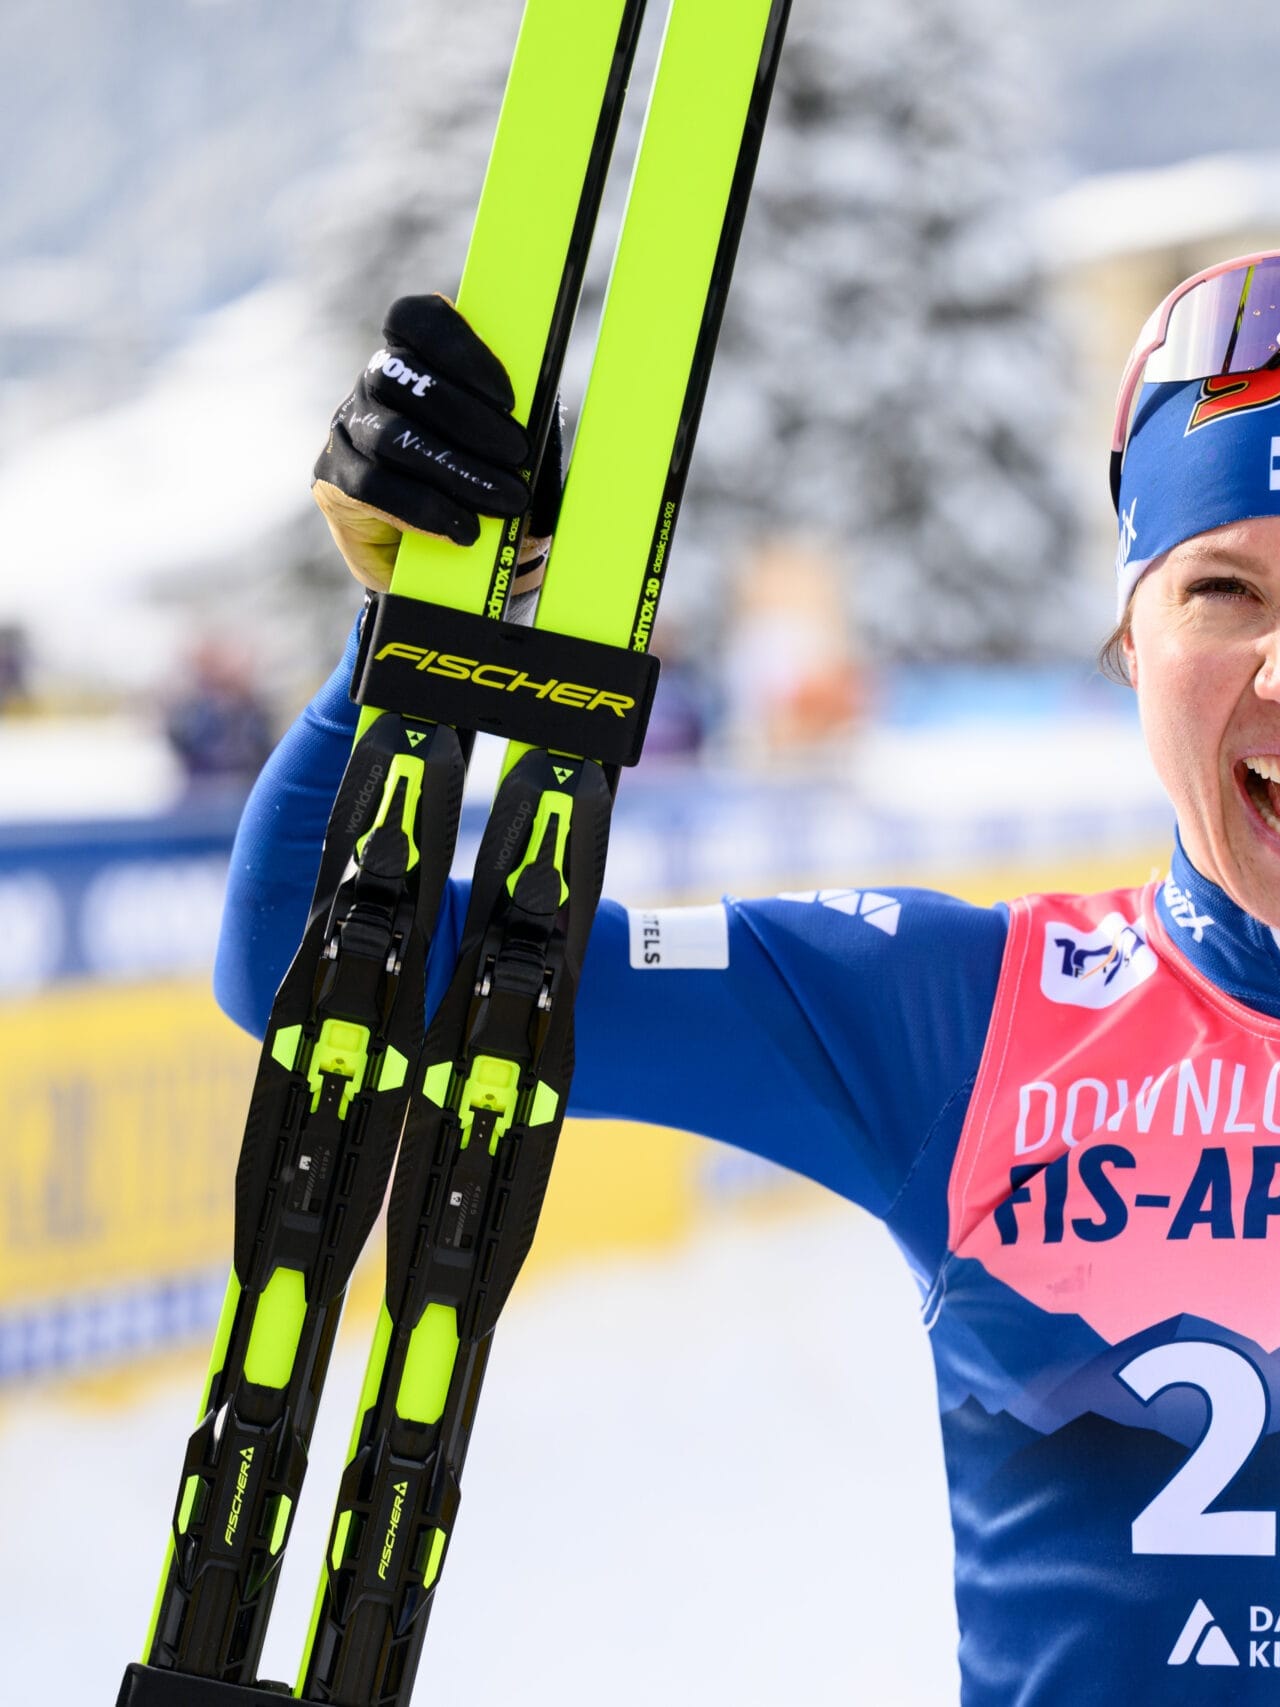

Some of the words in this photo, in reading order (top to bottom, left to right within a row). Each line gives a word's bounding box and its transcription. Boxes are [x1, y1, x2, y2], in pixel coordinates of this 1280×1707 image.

[664, 501, 676, 519] 902
[660, 519, 672, 541] plus
[500, 546, 515, 567] 3D
[653, 540, 667, 574] classic
[645, 577, 660, 599] 3D
[374, 642, 636, 719] FISCHER
[642, 913, 661, 965] TELS
[224, 1461, 251, 1546] FISCHER
[377, 1495, 405, 1580] FISCHER
